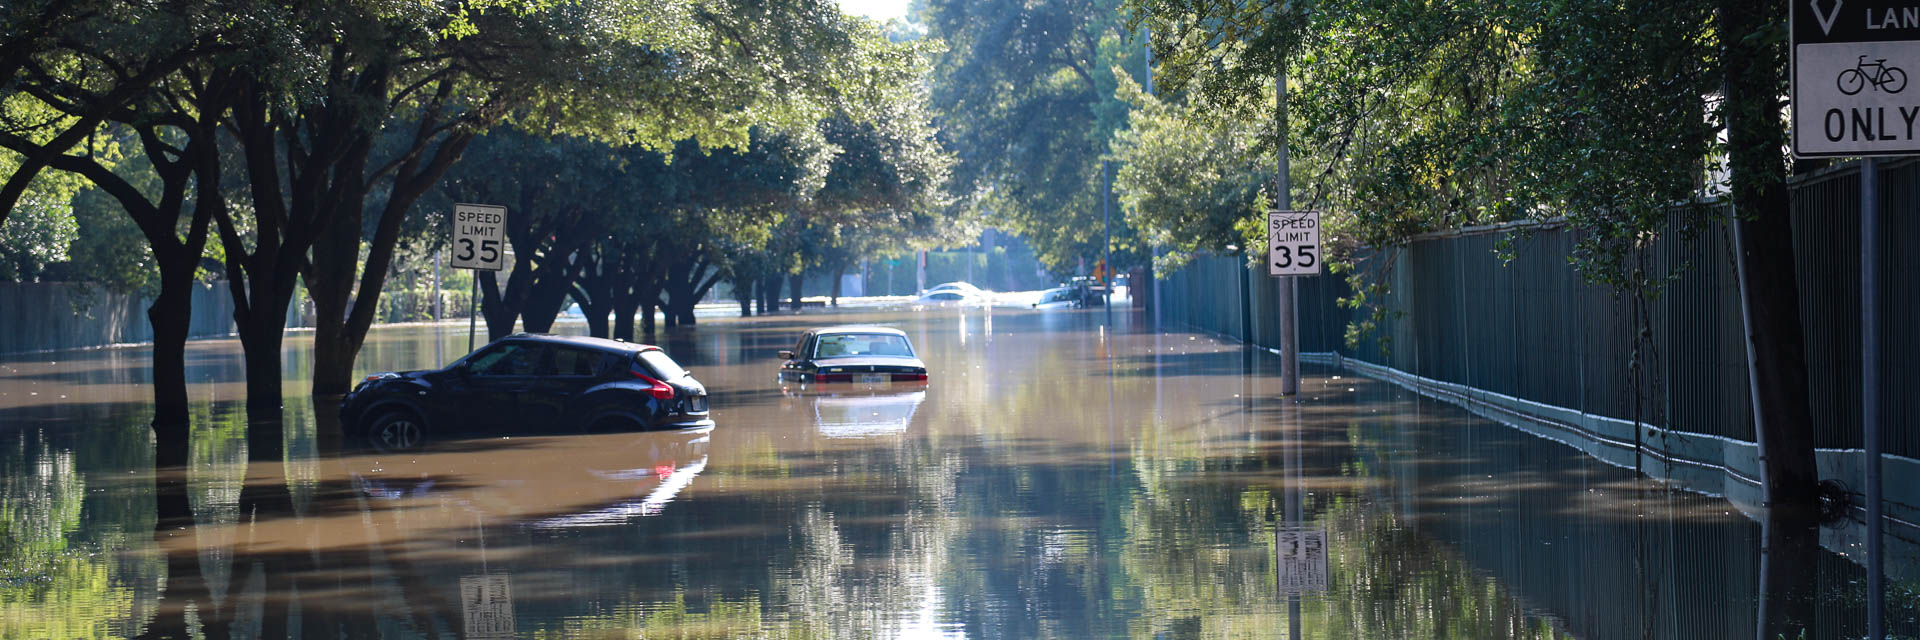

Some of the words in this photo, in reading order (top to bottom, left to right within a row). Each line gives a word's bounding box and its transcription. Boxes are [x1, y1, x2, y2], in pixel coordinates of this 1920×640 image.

[1866, 7, 1919, 29] LAN
[1824, 106, 1920, 142] ONLY
[458, 211, 502, 224] SPEED
[1272, 218, 1316, 230] SPEED
[462, 225, 496, 237] LIMIT
[1277, 231, 1311, 242] LIMIT
[456, 238, 499, 263] 35
[1274, 245, 1316, 269] 35
